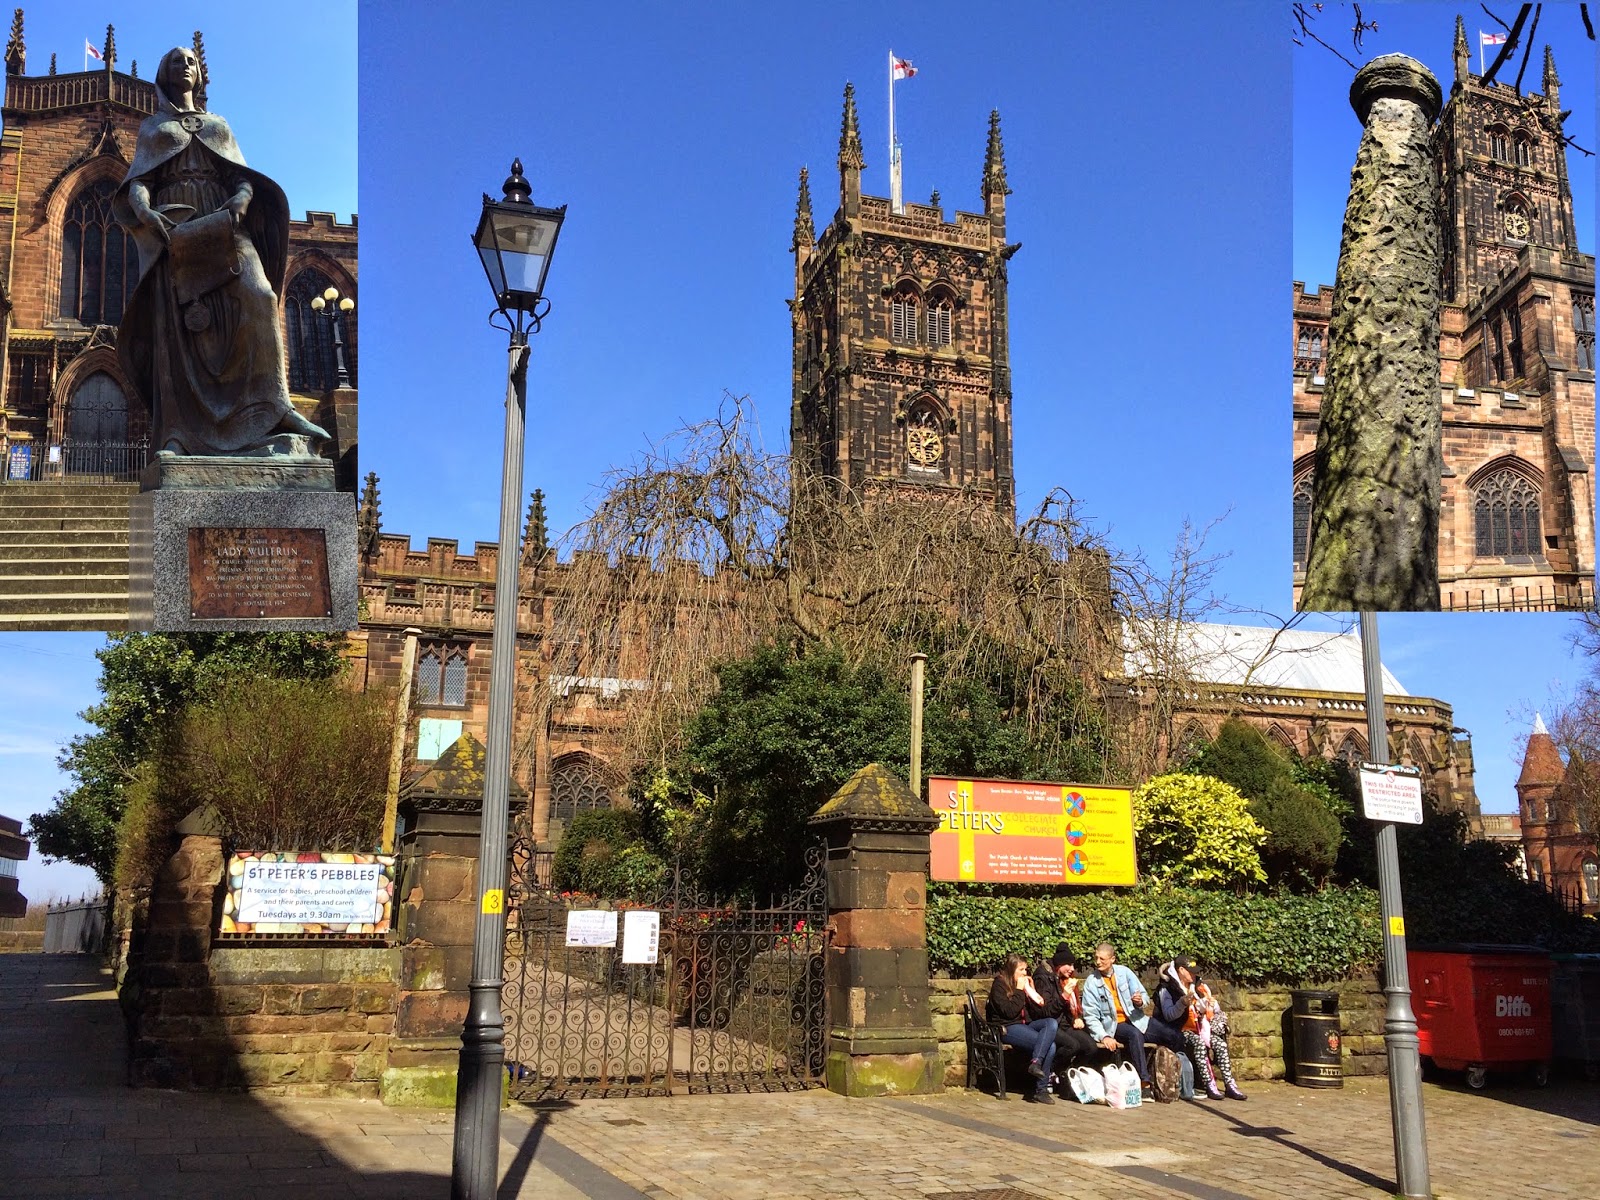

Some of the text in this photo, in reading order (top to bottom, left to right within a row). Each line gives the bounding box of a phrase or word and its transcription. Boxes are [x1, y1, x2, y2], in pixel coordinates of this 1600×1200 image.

[216, 546, 299, 556] LADY WULFRUN
[1367, 788, 1402, 797] RESTRICTED
[1394, 784, 1419, 793] ALCOHOL
[935, 810, 1004, 834] PETER'S
[1005, 813, 1058, 825] COLLEGIATE
[1023, 825, 1058, 836] CHURCH
[248, 867, 375, 881] ST PETER'S PEBBLES
[314, 888, 346, 896] preschool
[346, 888, 373, 896] children
[490, 894, 500, 909] 3
[258, 910, 297, 920] Tuesdays
[298, 911, 308, 919] at
[309, 910, 341, 919] 9.30am
[1396, 921, 1404, 932] 4
[1495, 995, 1532, 1017] Biffa
